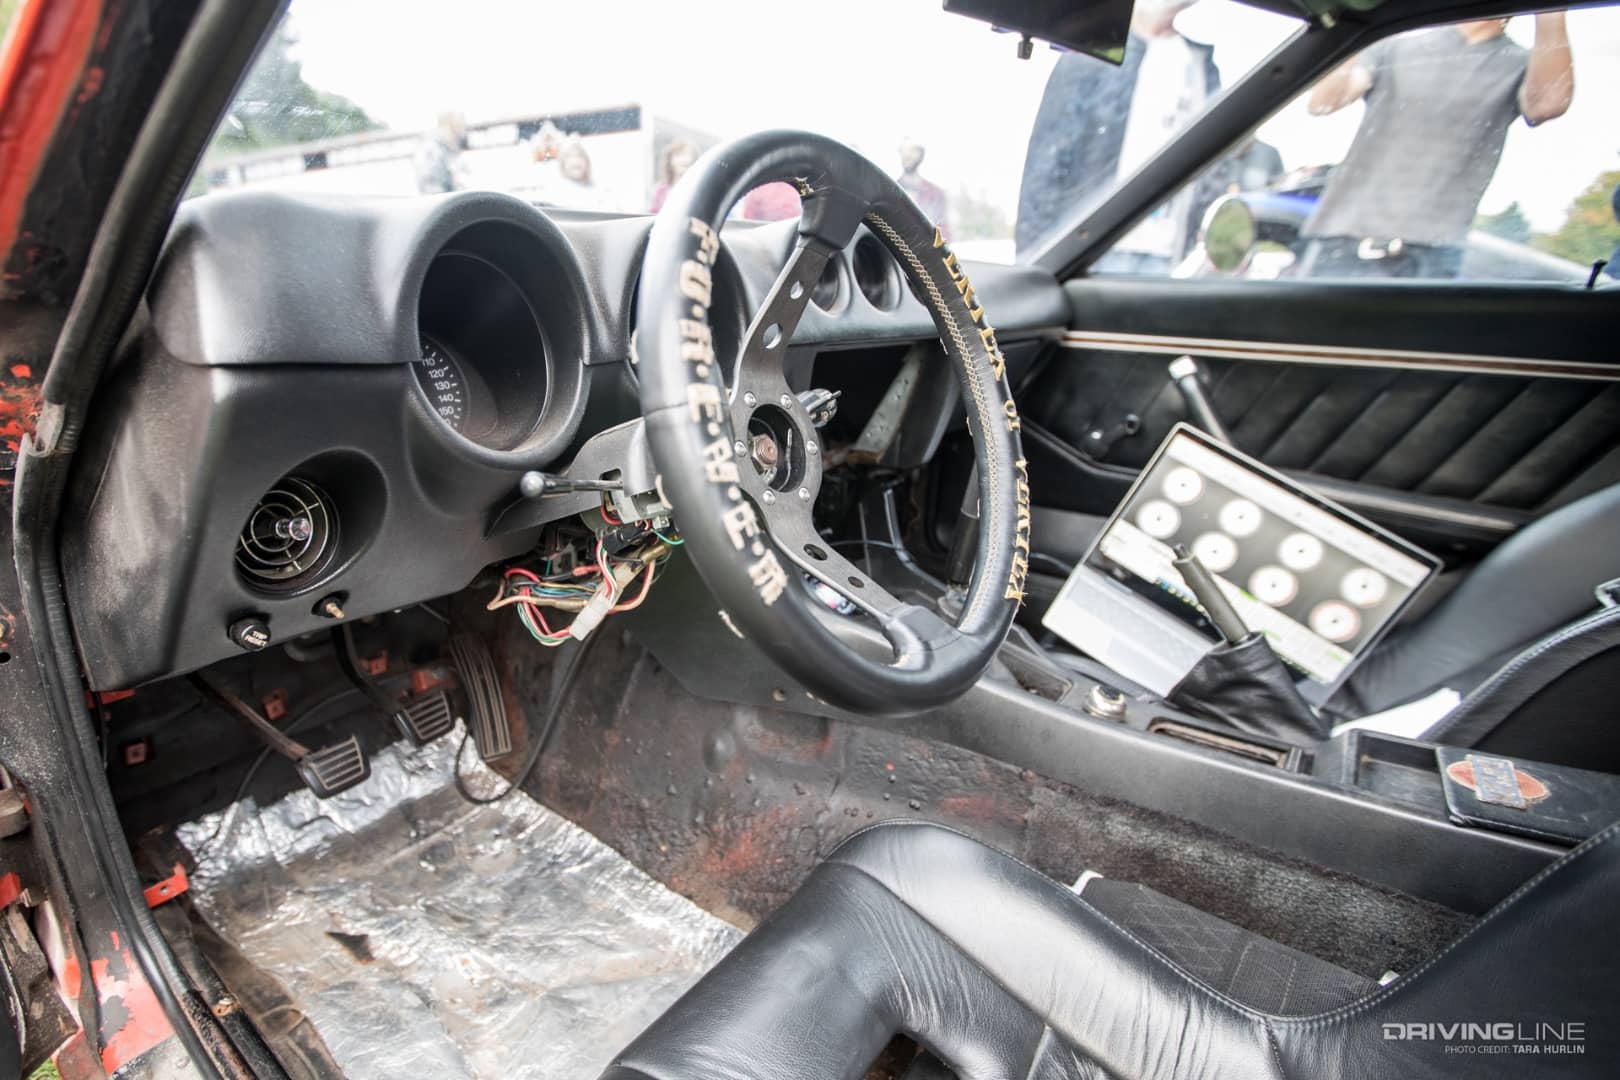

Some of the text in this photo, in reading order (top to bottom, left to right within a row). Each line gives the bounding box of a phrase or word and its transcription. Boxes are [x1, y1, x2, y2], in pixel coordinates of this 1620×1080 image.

[428, 369, 445, 379] 120
[434, 381, 450, 391] 130
[438, 393, 454, 403] 140
